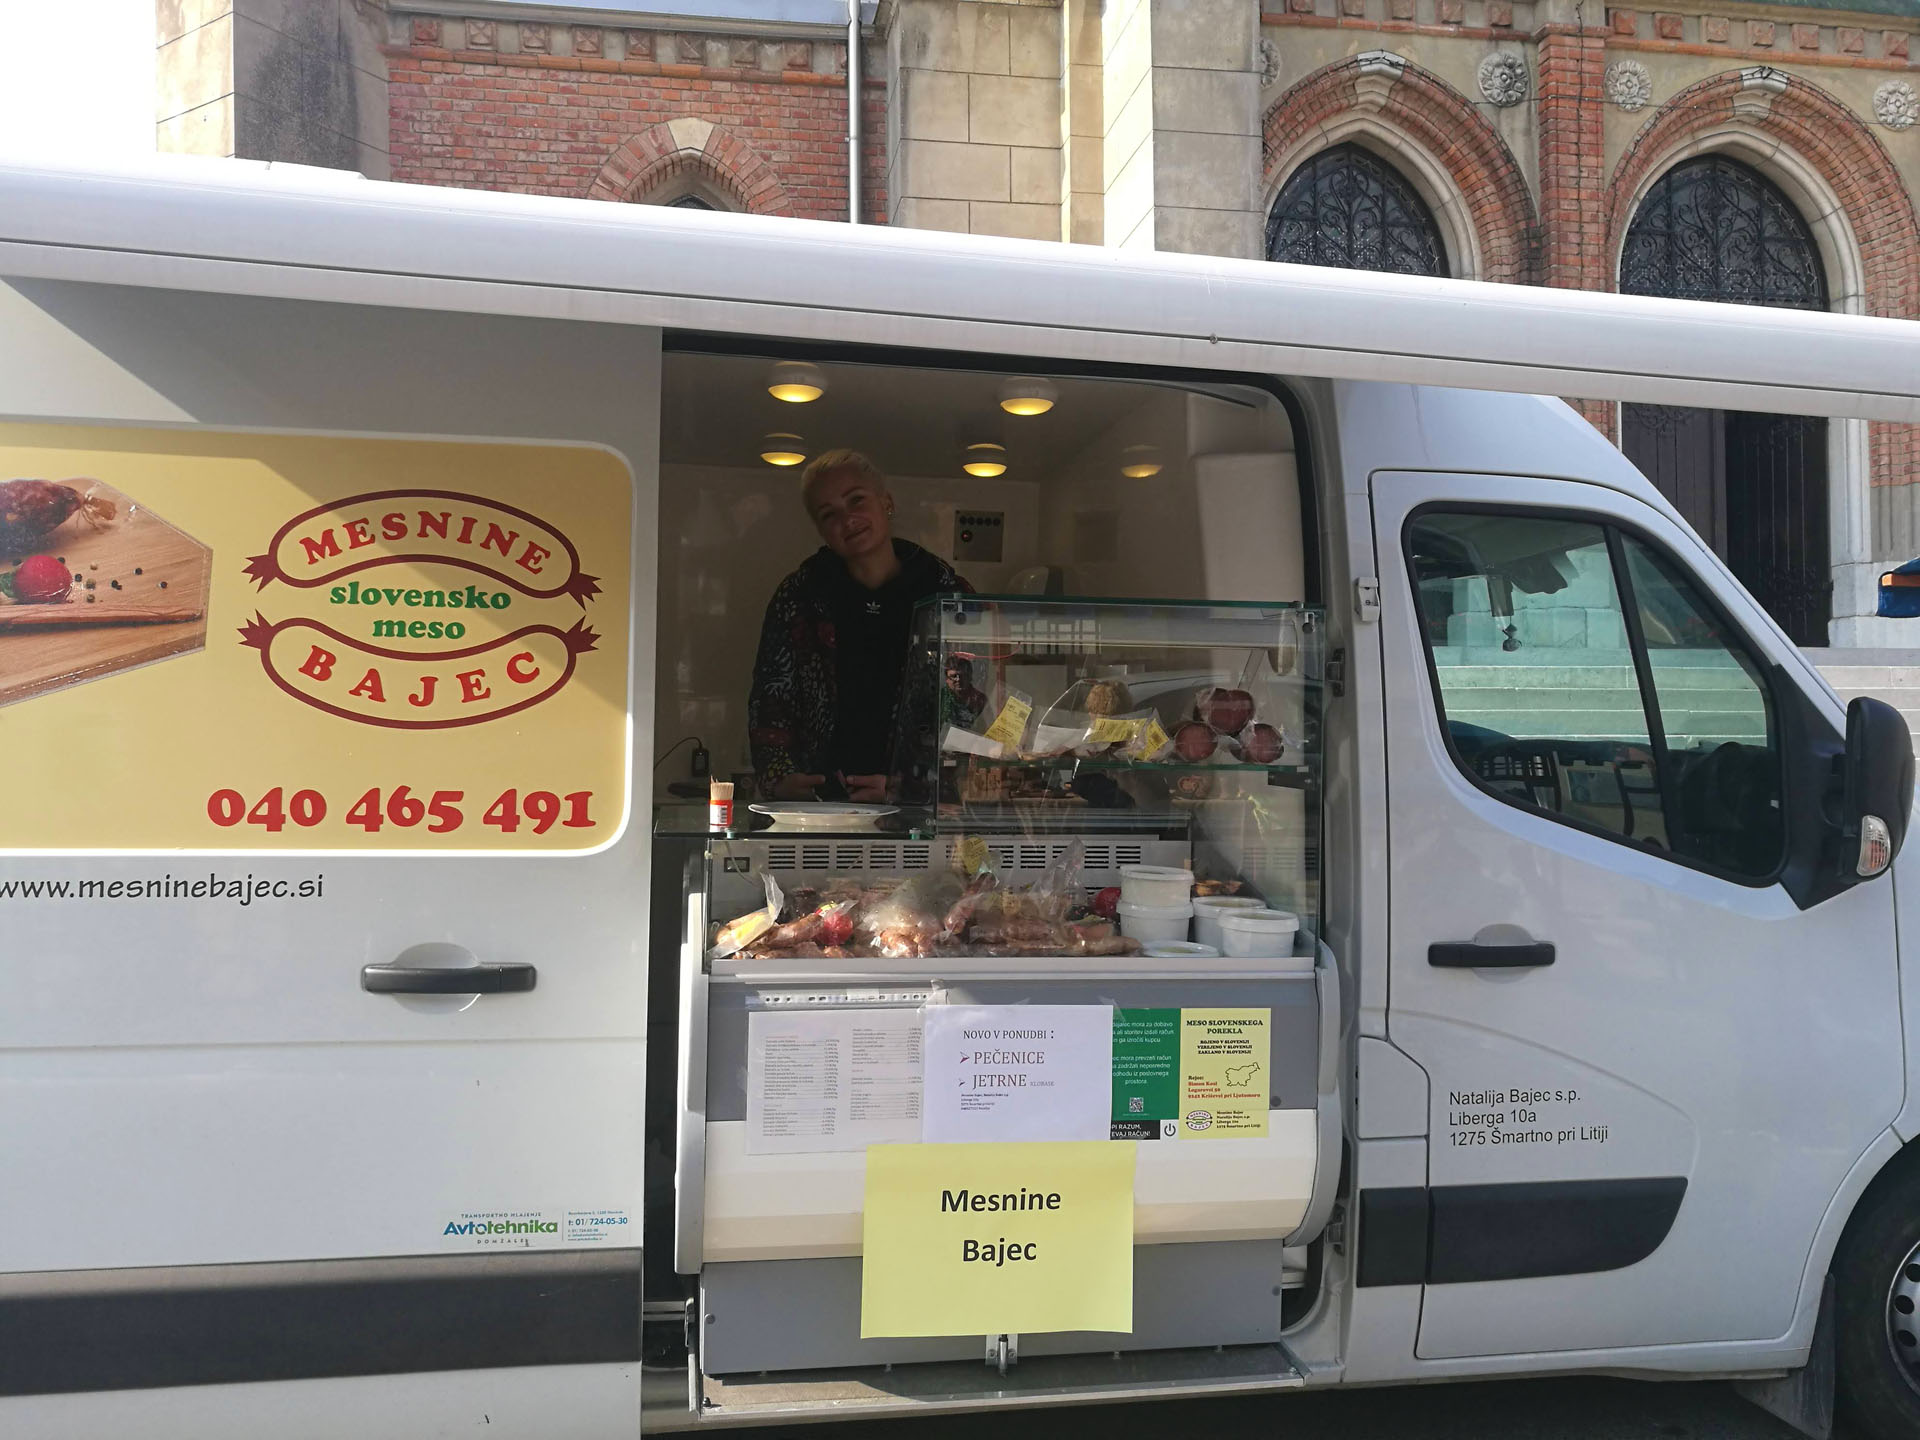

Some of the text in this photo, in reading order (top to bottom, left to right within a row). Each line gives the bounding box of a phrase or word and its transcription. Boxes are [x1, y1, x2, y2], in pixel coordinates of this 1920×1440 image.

[299, 511, 551, 575] MESNINE
[330, 581, 512, 610] slovensko
[372, 618, 466, 640] meso
[298, 645, 541, 707] BAJEC
[207, 785, 597, 835] 040 465 491
[0, 873, 324, 906] www.mesninebajec.si
[963, 1030, 992, 1040] NOVO
[993, 1030, 1001, 1040] V
[1002, 1030, 1047, 1040] PONUDBI
[974, 1049, 1045, 1065] PEČENICE
[972, 1074, 1027, 1090] JETRNE
[1450, 1088, 1581, 1107] Natalija Bajec s.p.
[1449, 1109, 1537, 1127] Liberga 10a
[1450, 1126, 1609, 1146] 1275 Šmartno pri Litiji
[941, 1187, 1061, 1212] Mesnine
[443, 1219, 558, 1235] Avtotehnika
[962, 1238, 1037, 1267] Bajec
